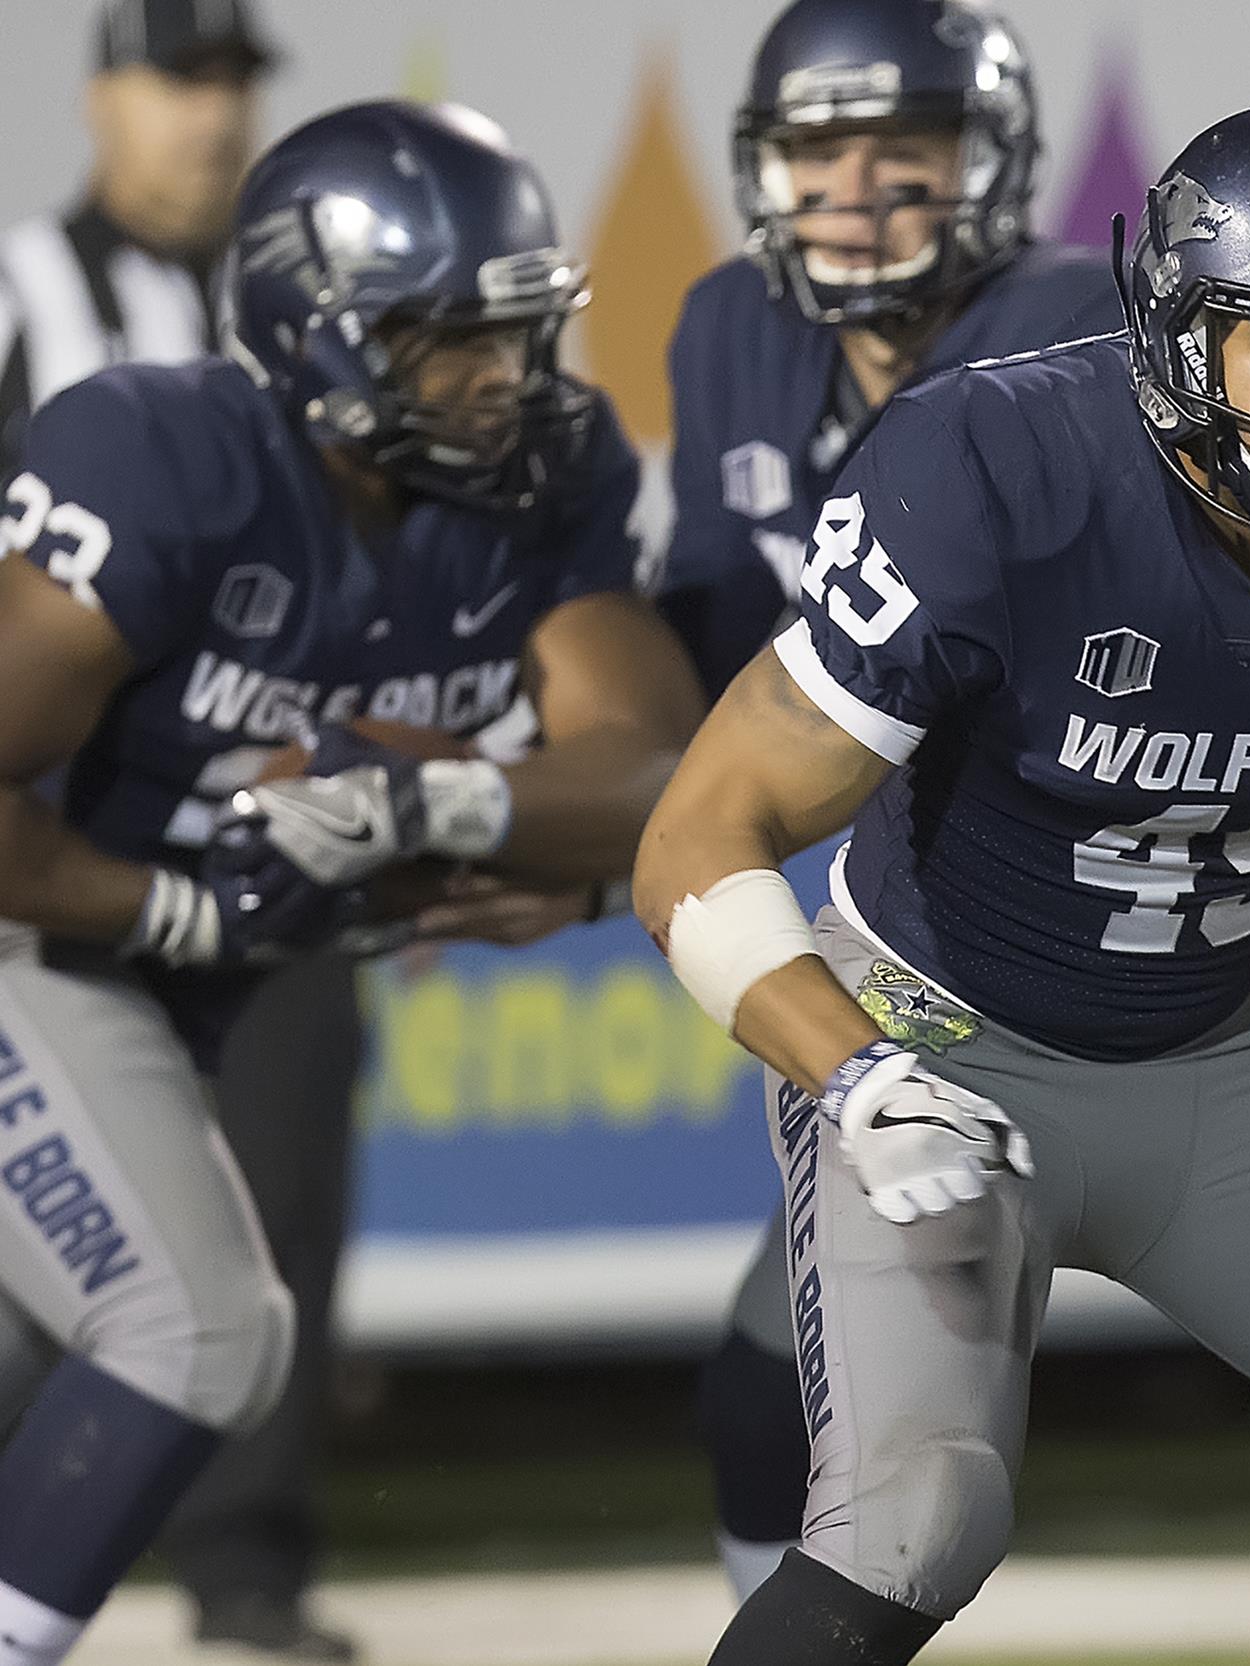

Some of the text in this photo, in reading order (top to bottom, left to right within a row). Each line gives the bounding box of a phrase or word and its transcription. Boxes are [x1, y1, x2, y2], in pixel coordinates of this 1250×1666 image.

[1176, 331, 1225, 401] Ridd
[800, 491, 921, 648] 45
[3, 1132, 140, 1295] BORN
[797, 1263, 834, 1441] BORN
